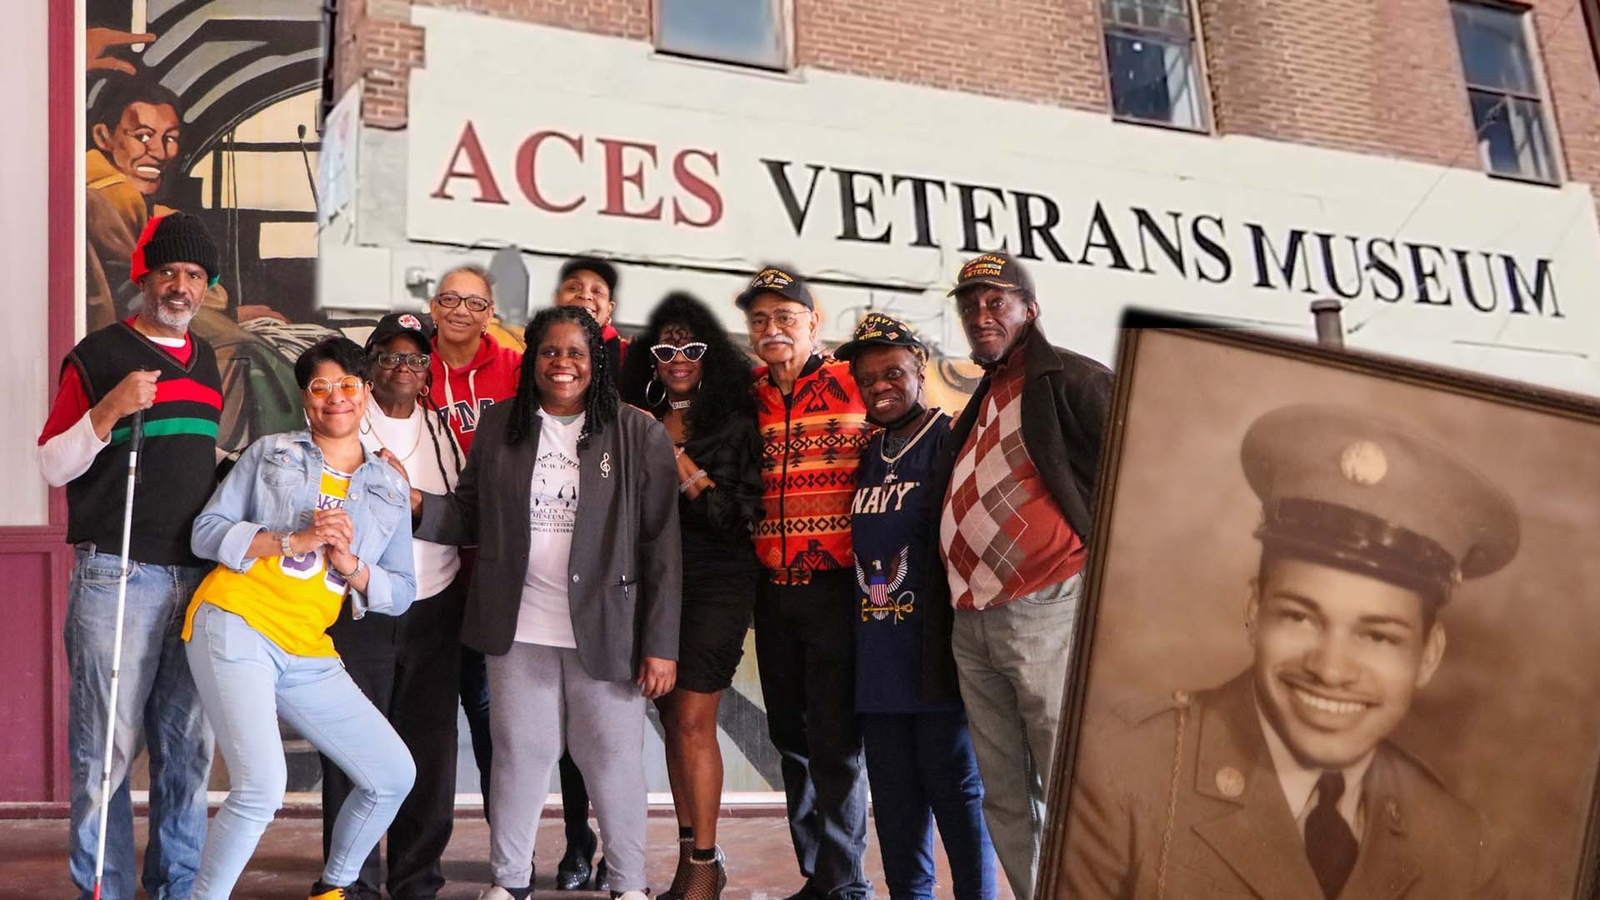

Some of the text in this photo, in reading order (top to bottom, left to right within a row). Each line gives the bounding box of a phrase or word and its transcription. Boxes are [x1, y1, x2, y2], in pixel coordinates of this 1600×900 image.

[430, 120, 1567, 319] ACES VETERANS MUSEUM
[868, 315, 895, 327] NAVY
[850, 481, 916, 515] NAVY
